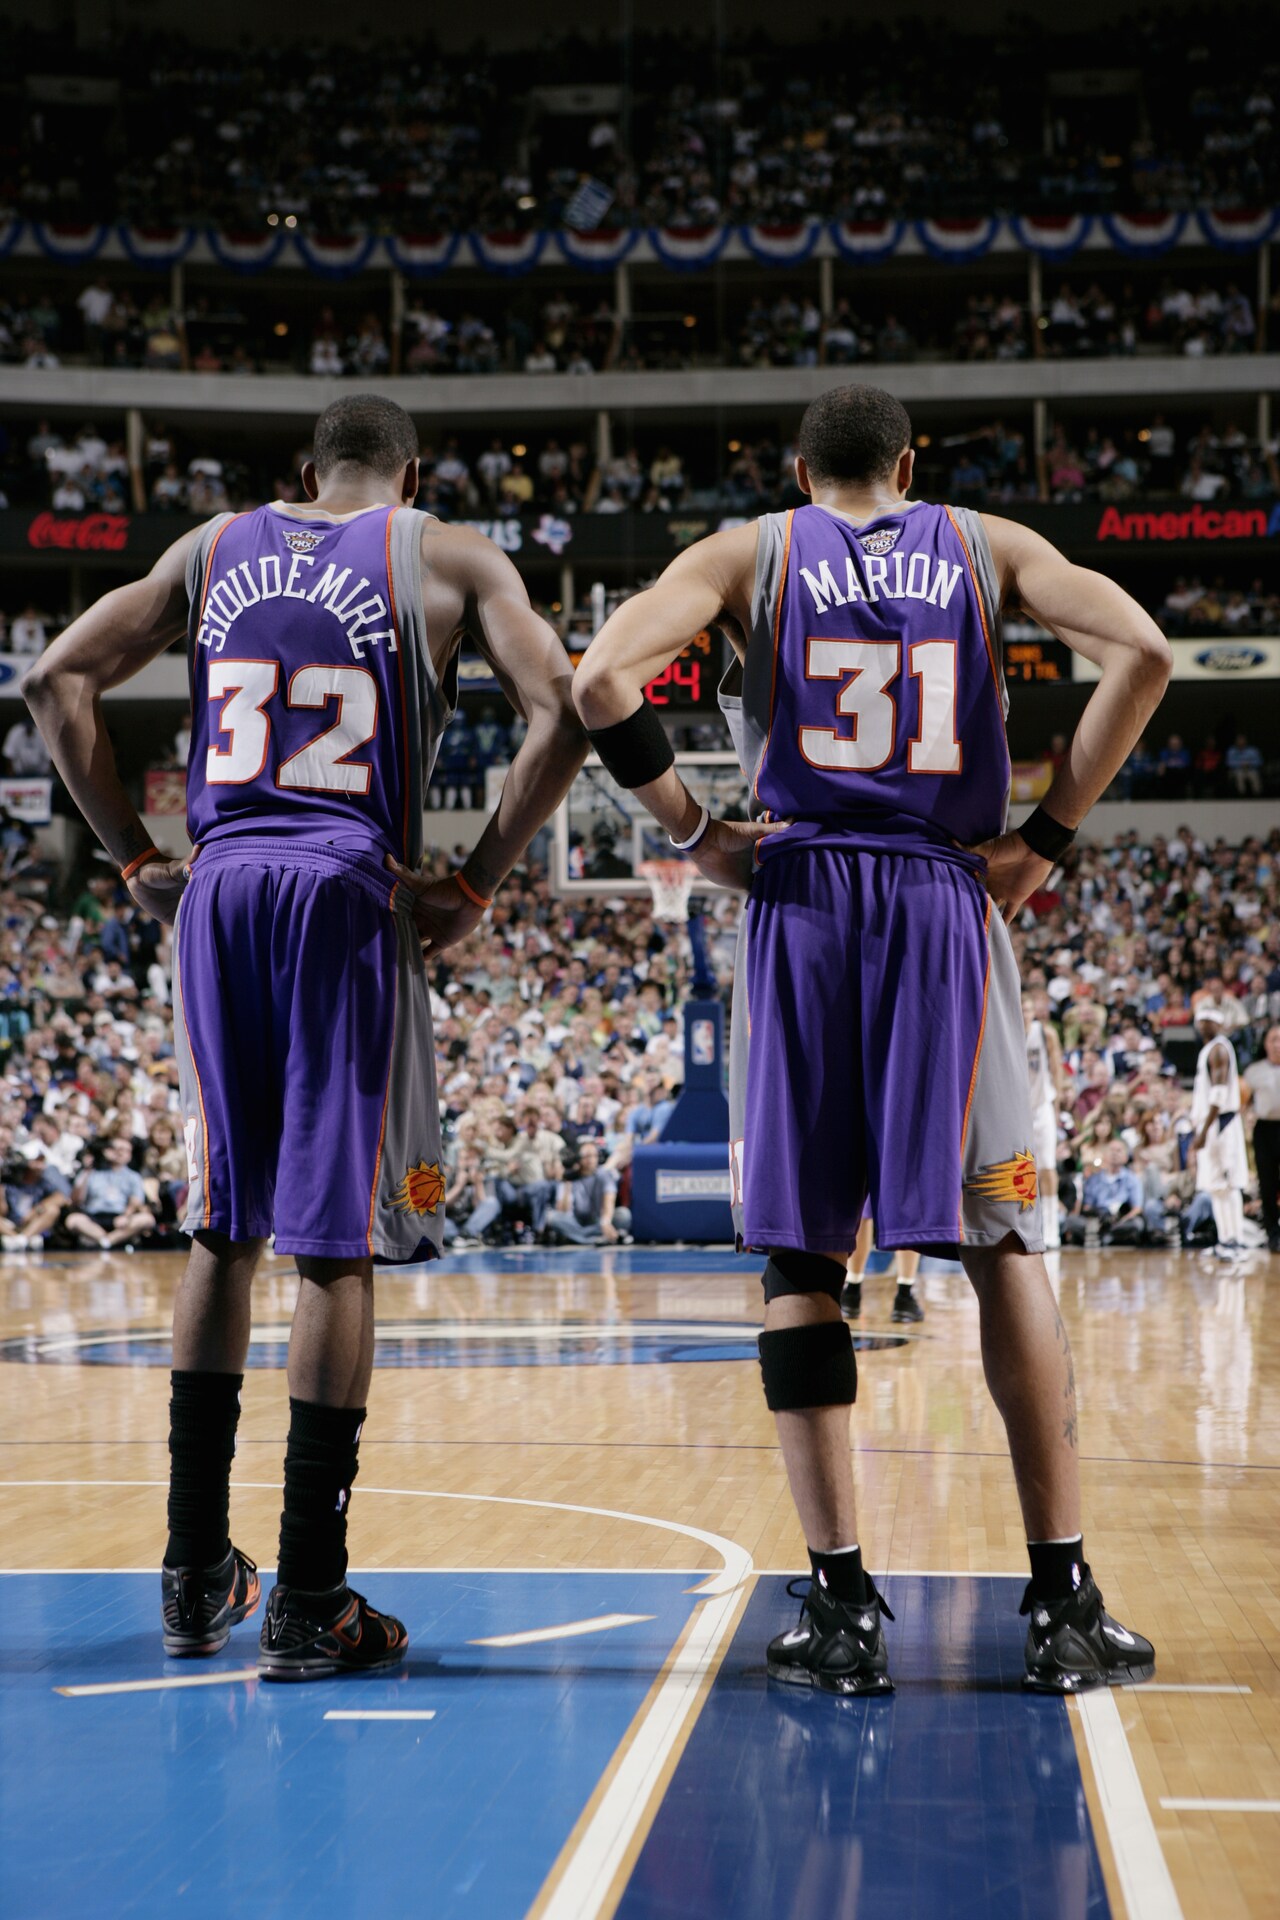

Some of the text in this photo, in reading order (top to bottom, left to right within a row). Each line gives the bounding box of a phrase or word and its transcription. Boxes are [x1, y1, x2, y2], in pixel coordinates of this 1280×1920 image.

[1097, 503, 1267, 541] American
[198, 553, 398, 660] STOUDEMIRE
[798, 552, 964, 615] MARION
[643, 660, 701, 705] 24
[798, 637, 963, 775] 31
[206, 658, 379, 796] 32
